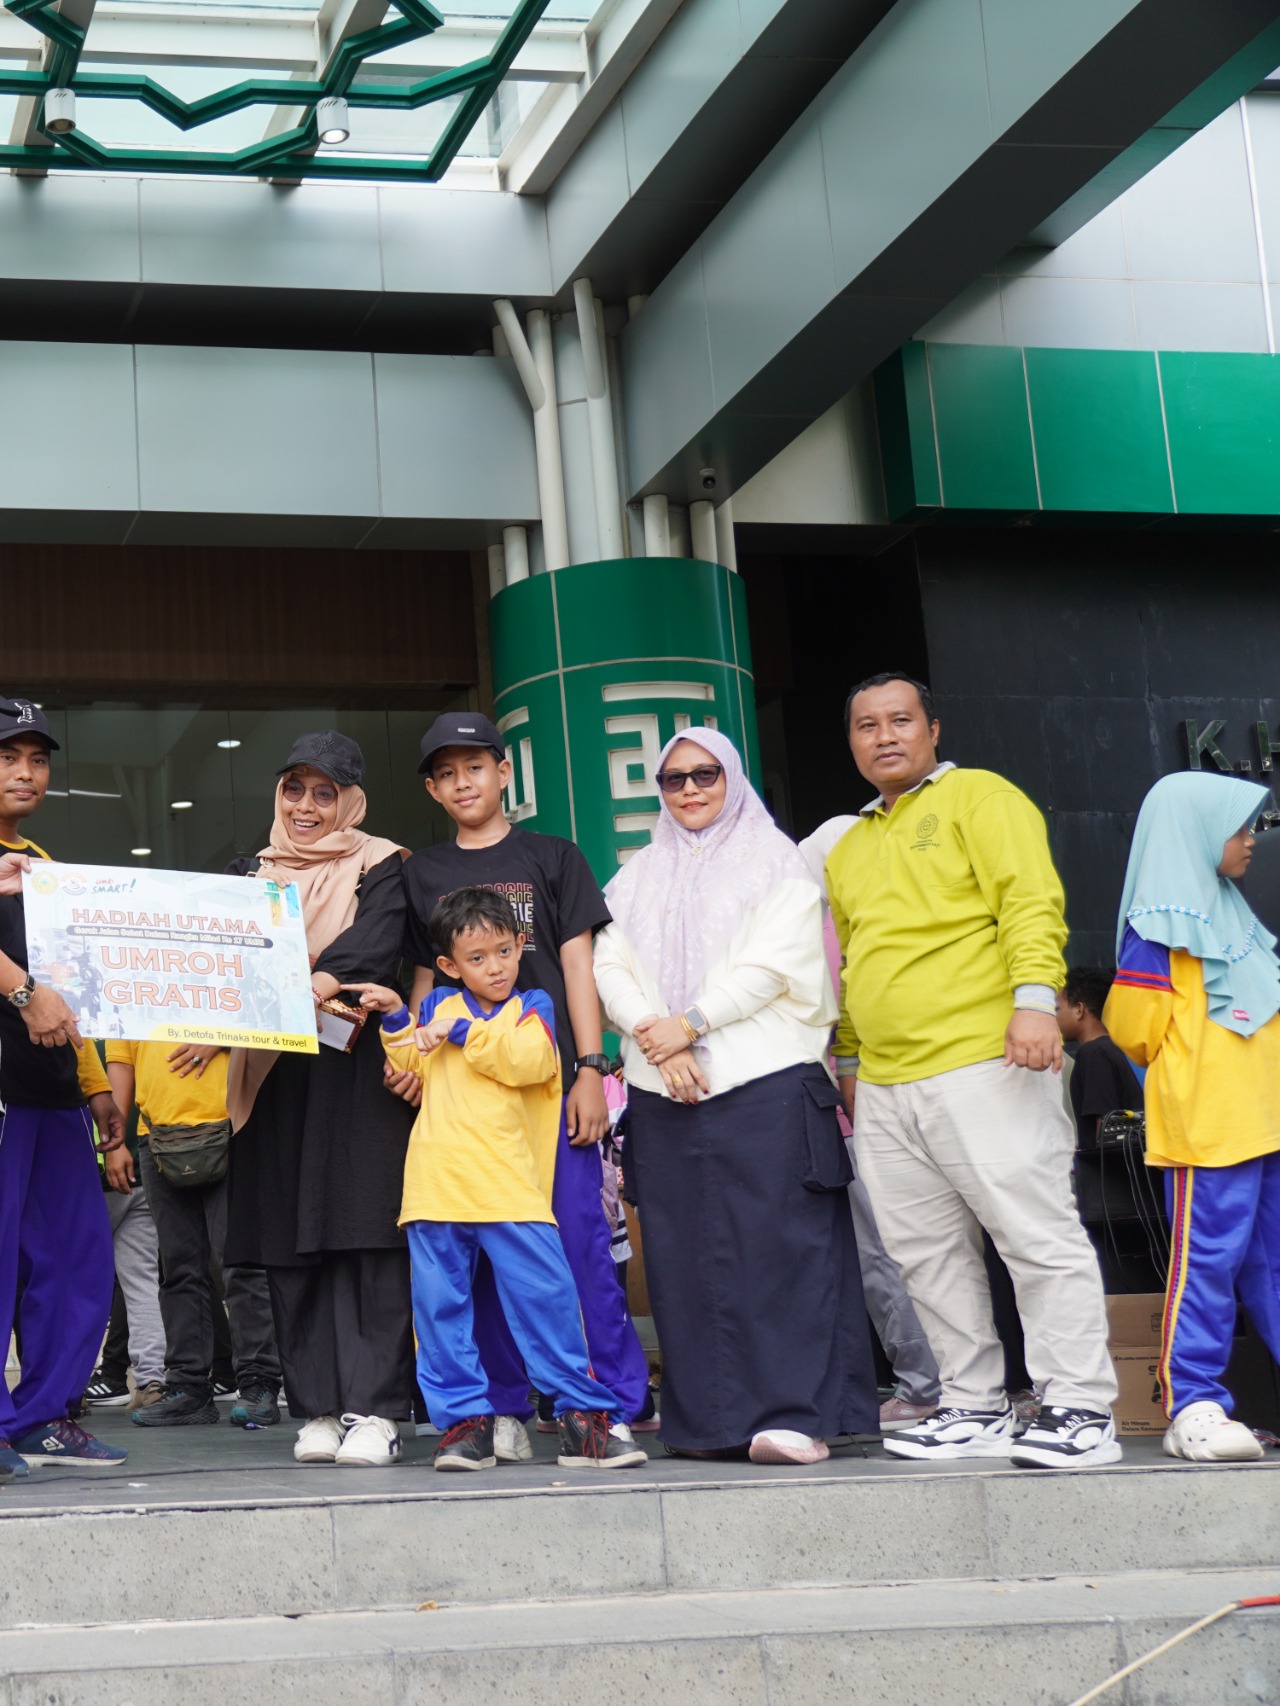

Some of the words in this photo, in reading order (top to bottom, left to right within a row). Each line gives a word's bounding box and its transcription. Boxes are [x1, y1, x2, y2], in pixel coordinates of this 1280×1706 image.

[72, 908, 171, 928] HADIAH
[176, 914, 263, 935] UTAMA
[100, 945, 244, 978] UMROH
[103, 979, 243, 1012] GRATIS
[167, 1028, 181, 1038] By.
[184, 1029, 214, 1040] Detofa
[216, 1031, 250, 1043] Trinaka
[252, 1035, 270, 1044] tour
[272, 1036, 280, 1045] &
[281, 1038, 307, 1047] travel
